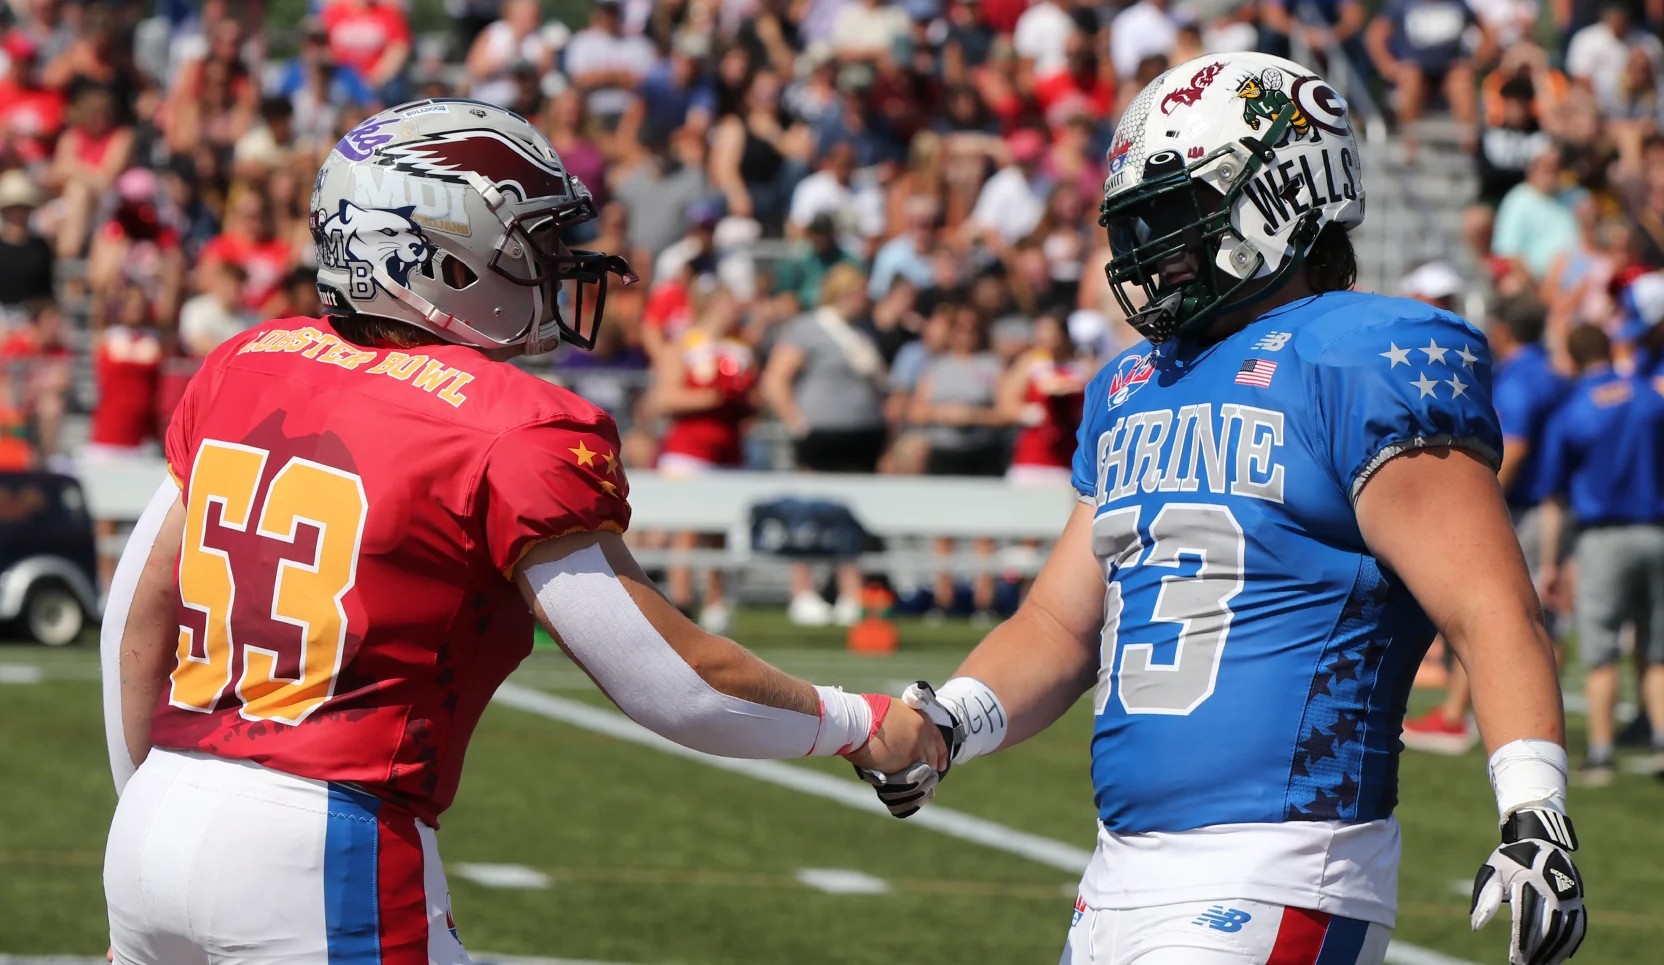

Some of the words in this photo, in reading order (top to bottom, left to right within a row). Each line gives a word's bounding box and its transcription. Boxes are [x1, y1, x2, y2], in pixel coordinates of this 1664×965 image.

[406, 105, 447, 117] BULLDOGS
[353, 165, 469, 224] MDI
[1241, 148, 1357, 230] WELLS
[365, 352, 476, 408] BOWL
[169, 438, 369, 727] 53
